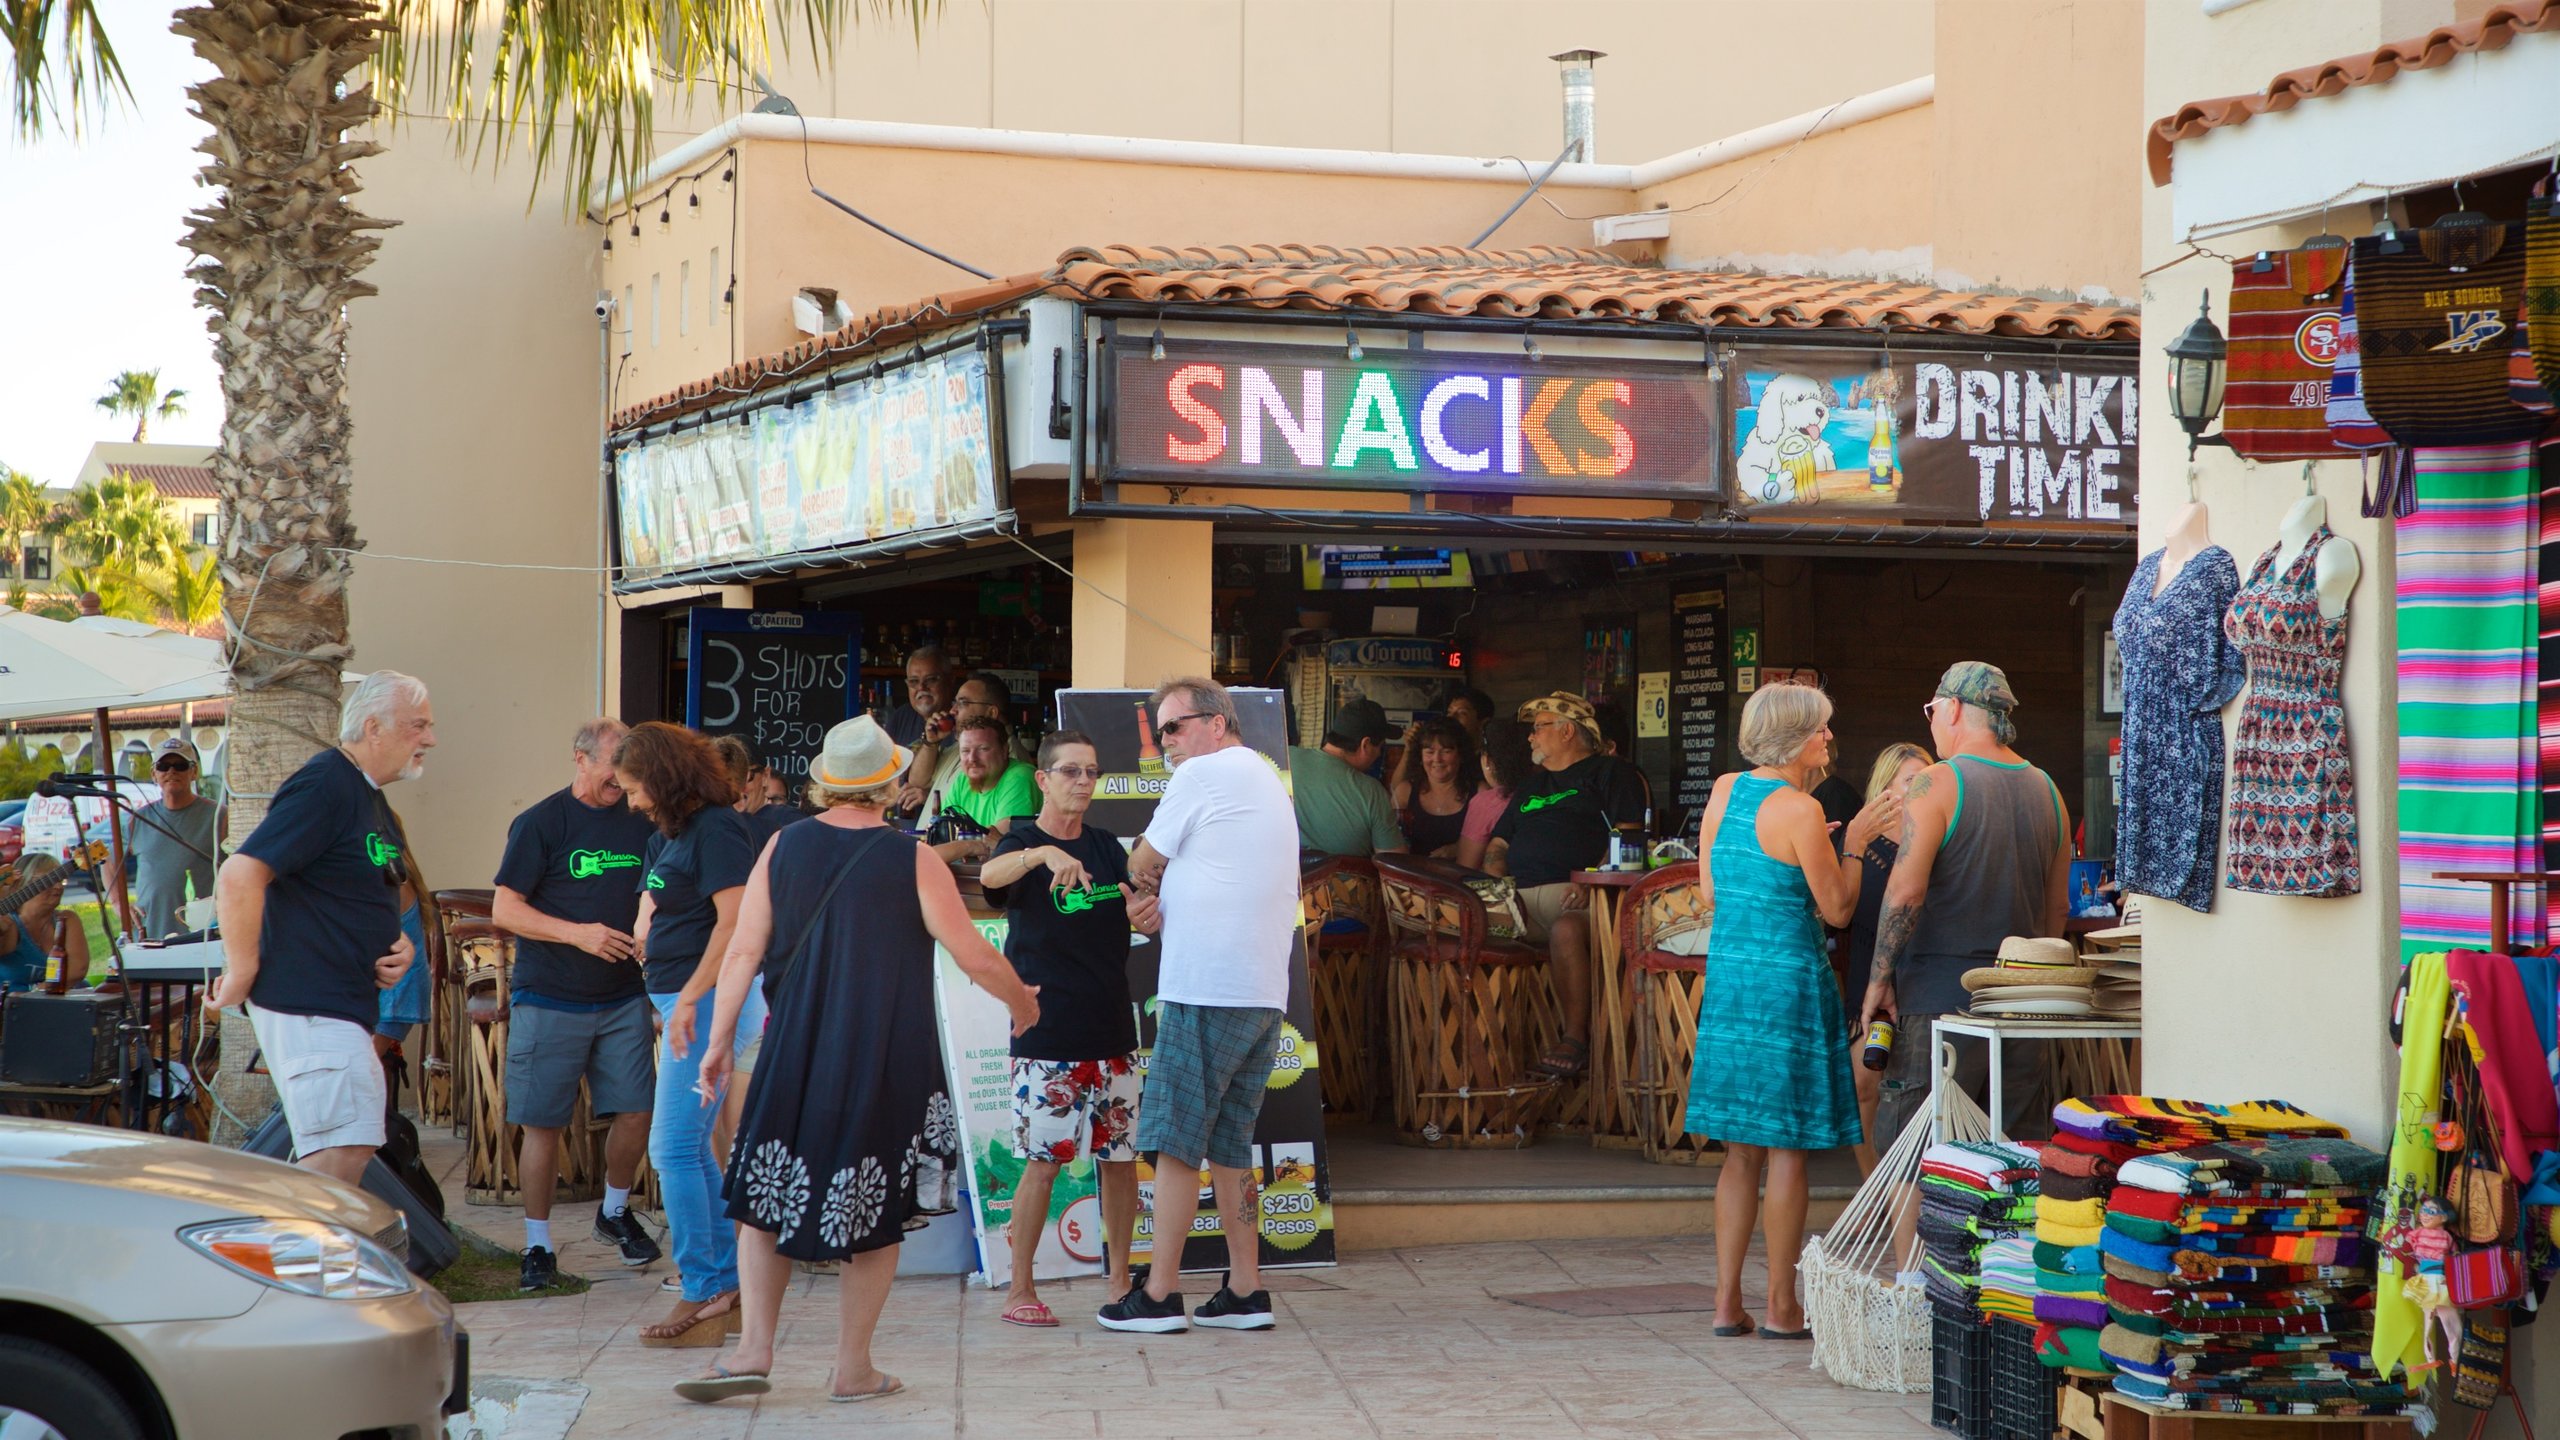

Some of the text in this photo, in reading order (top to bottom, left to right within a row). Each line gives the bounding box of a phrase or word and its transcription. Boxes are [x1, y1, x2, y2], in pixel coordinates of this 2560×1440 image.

[2306, 242, 2341, 250] SEAFOLLY
[2424, 286, 2502, 307] BLUE BOMBERS
[2289, 382, 2332, 407] 49E
[1166, 363, 1635, 476] SNACKS
[1968, 445, 2122, 520] TIME
[1357, 552, 1381, 560] ANDRADE
[765, 615, 802, 626] PACIFICO
[1685, 613, 1712, 624] MARGARITA
[1695, 626, 1715, 638] COLADA
[1684, 640, 1714, 653] LONG ISLAND
[1356, 639, 1433, 668] Corona
[703, 639, 848, 726] 3 SHOTS
[1004, 678, 1036, 692] NTIME
[753, 688, 801, 717] FOR
[1682, 709, 1716, 721] DIRTY MONKEY
[1682, 723, 1716, 735] BLOODY MARY
[1695, 737, 1715, 748] BLANCO
[1687, 765, 1710, 776] MIMOSAS
[1105, 777, 1169, 793] All bee
[598, 850, 632, 862] Alonso
[1090, 882, 1118, 894] lonso
[965, 1047, 1010, 1059] ALL ORGANIC
[980, 1061, 1003, 1071] FRESH
[971, 1074, 1011, 1085] INGREDIENT
[968, 1087, 1012, 1099] and OUR SEC
[973, 1099, 1012, 1112] HOUSE REC
[1262, 1193, 1313, 1215] $250
[1138, 1215, 1153, 1234] Ji
[1264, 1218, 1316, 1235] Pesos
[1067, 1219, 1082, 1244] $
